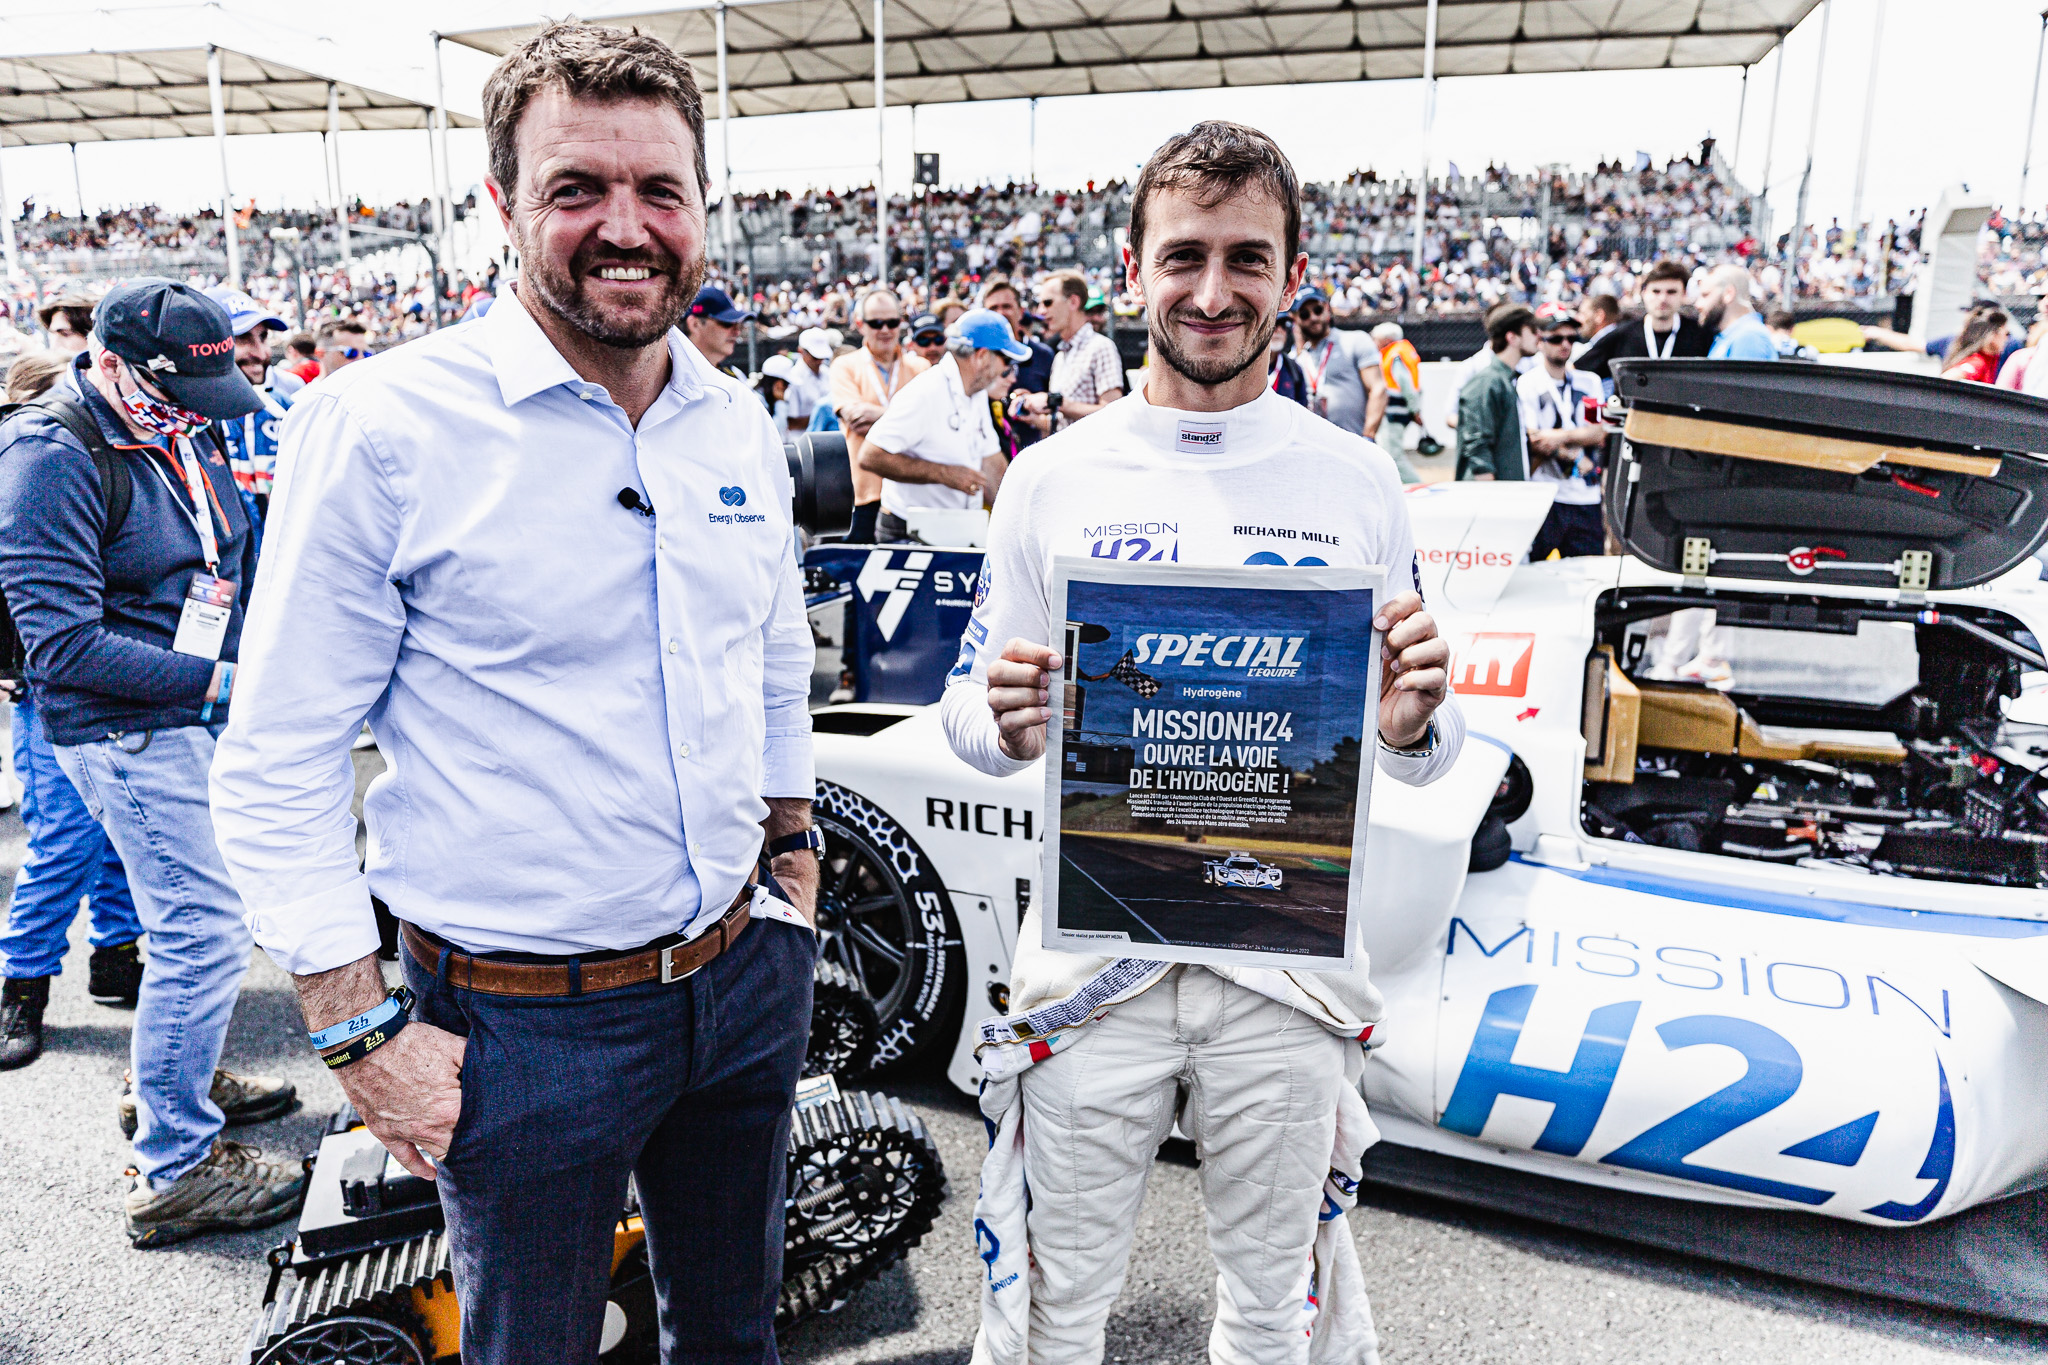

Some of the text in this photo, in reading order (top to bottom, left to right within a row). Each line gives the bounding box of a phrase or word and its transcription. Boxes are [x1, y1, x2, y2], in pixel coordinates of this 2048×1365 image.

[708, 513, 766, 525] Energy Observer
[1083, 522, 1178, 539] MISSION
[1233, 525, 1340, 547] RICHARD MILLE
[1134, 632, 1305, 668] SPÉCIAL
[1246, 667, 1298, 678] L'ÉQUIPE
[1182, 687, 1242, 700] Hydrogène
[1132, 707, 1294, 742] MISSIONH24
[1143, 743, 1279, 769] OUVRE LA VOIE
[1129, 768, 1153, 789] DE
[1156, 767, 1280, 794] L'HYDROGÈNE
[926, 797, 1044, 842] RICH
[914, 891, 947, 934] 53
[1445, 916, 1951, 1039] MISSION
[1438, 983, 1956, 1222] H24
